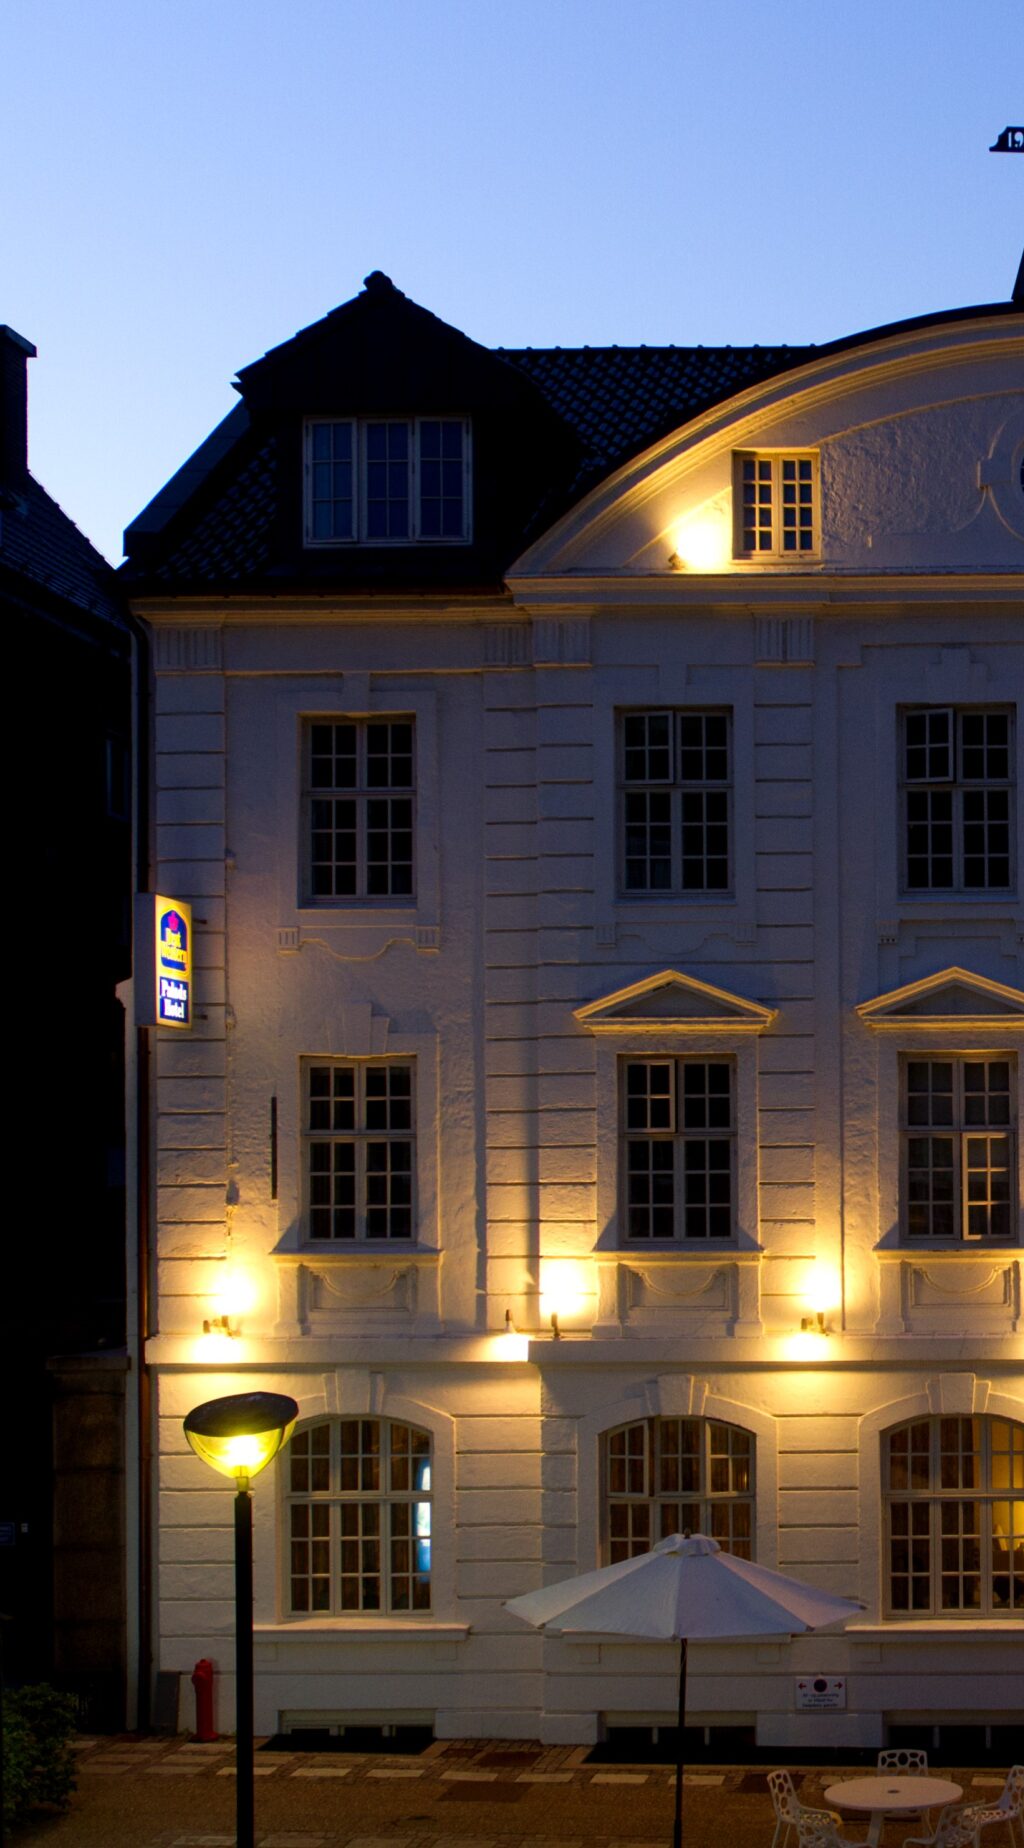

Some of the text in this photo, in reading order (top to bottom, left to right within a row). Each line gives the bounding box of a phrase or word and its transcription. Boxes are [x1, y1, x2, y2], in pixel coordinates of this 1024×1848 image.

[165, 927, 181, 948] Best
[161, 941, 187, 964] Western
[164, 998, 185, 1019] Hotel
